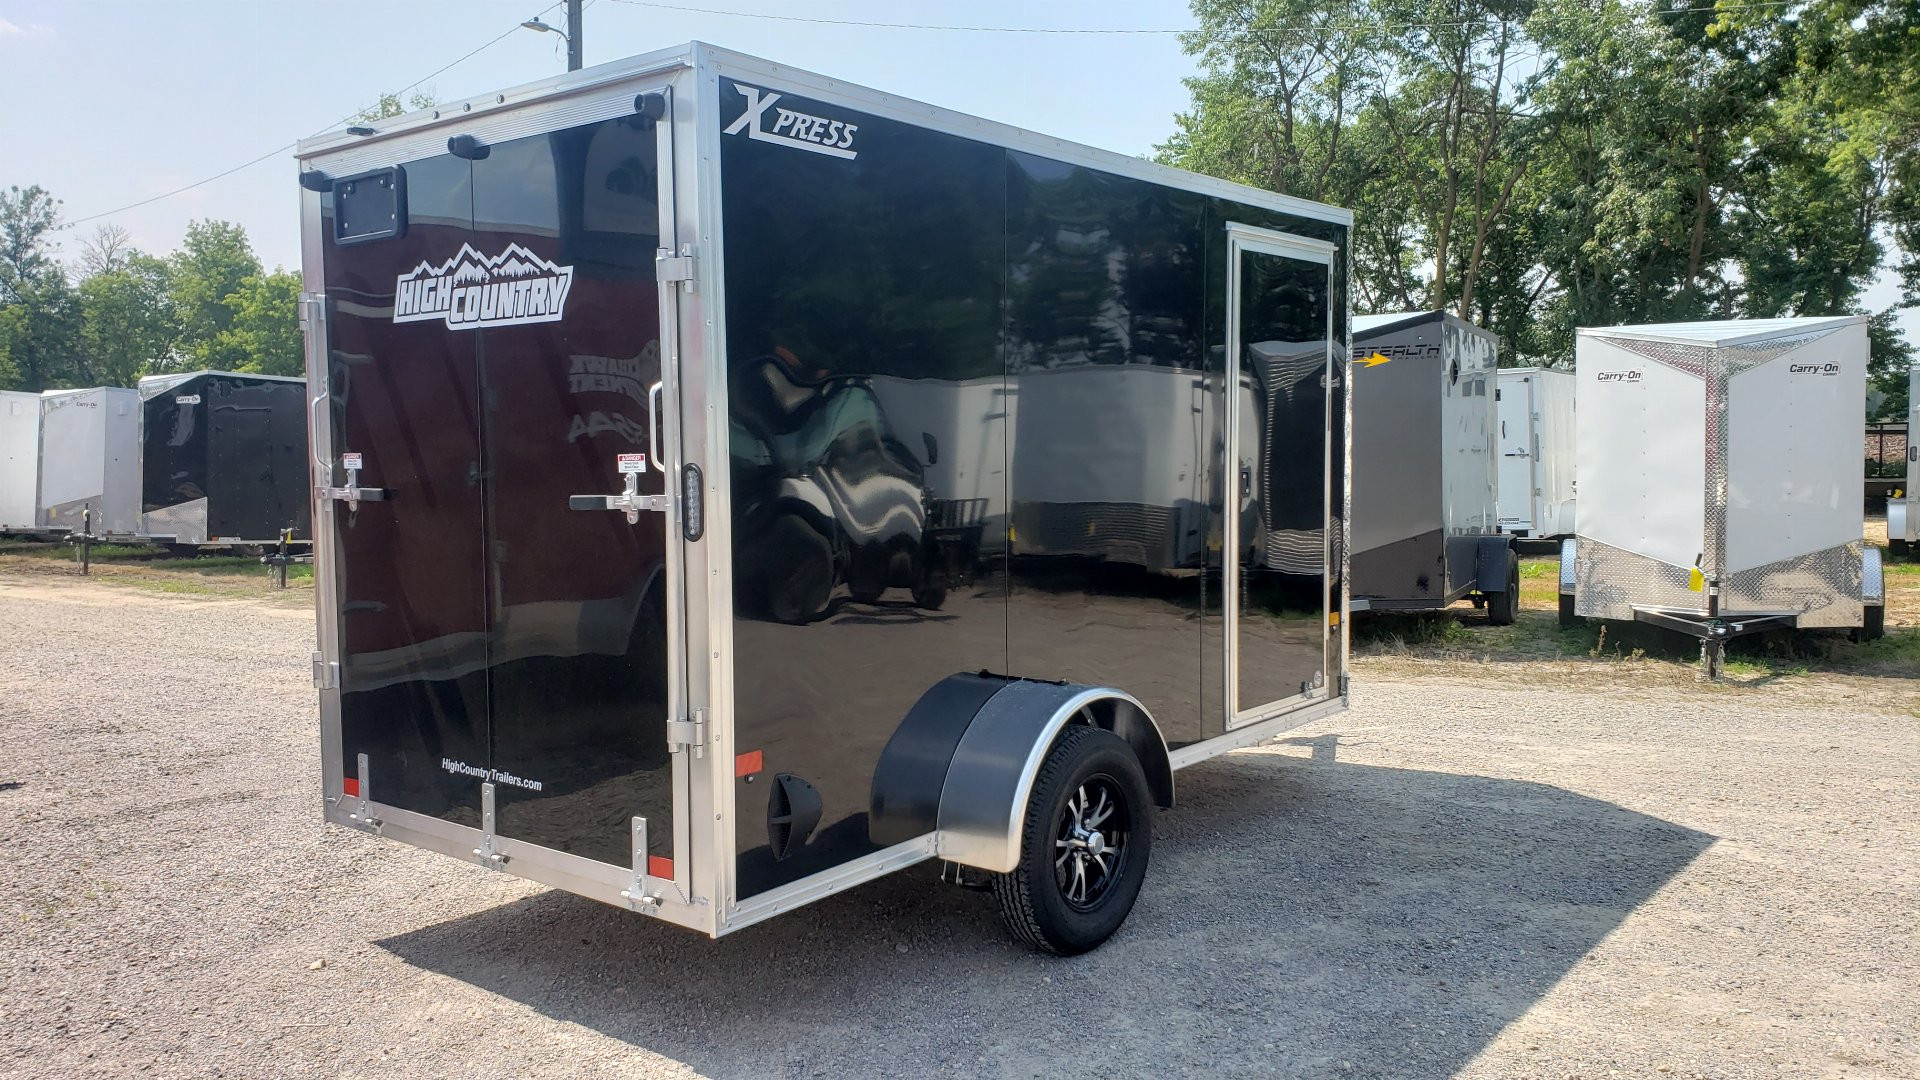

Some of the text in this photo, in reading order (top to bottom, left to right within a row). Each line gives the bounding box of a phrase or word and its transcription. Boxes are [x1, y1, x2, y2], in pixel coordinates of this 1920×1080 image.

[399, 276, 452, 315] HIGH
[450, 275, 567, 322] COUNTRY
[1353, 344, 1441, 358] STEALTH
[1597, 370, 1641, 381] Carry-On
[1789, 363, 1839, 374] Carry-On
[441, 757, 542, 791] HighCountryTrailers.com
